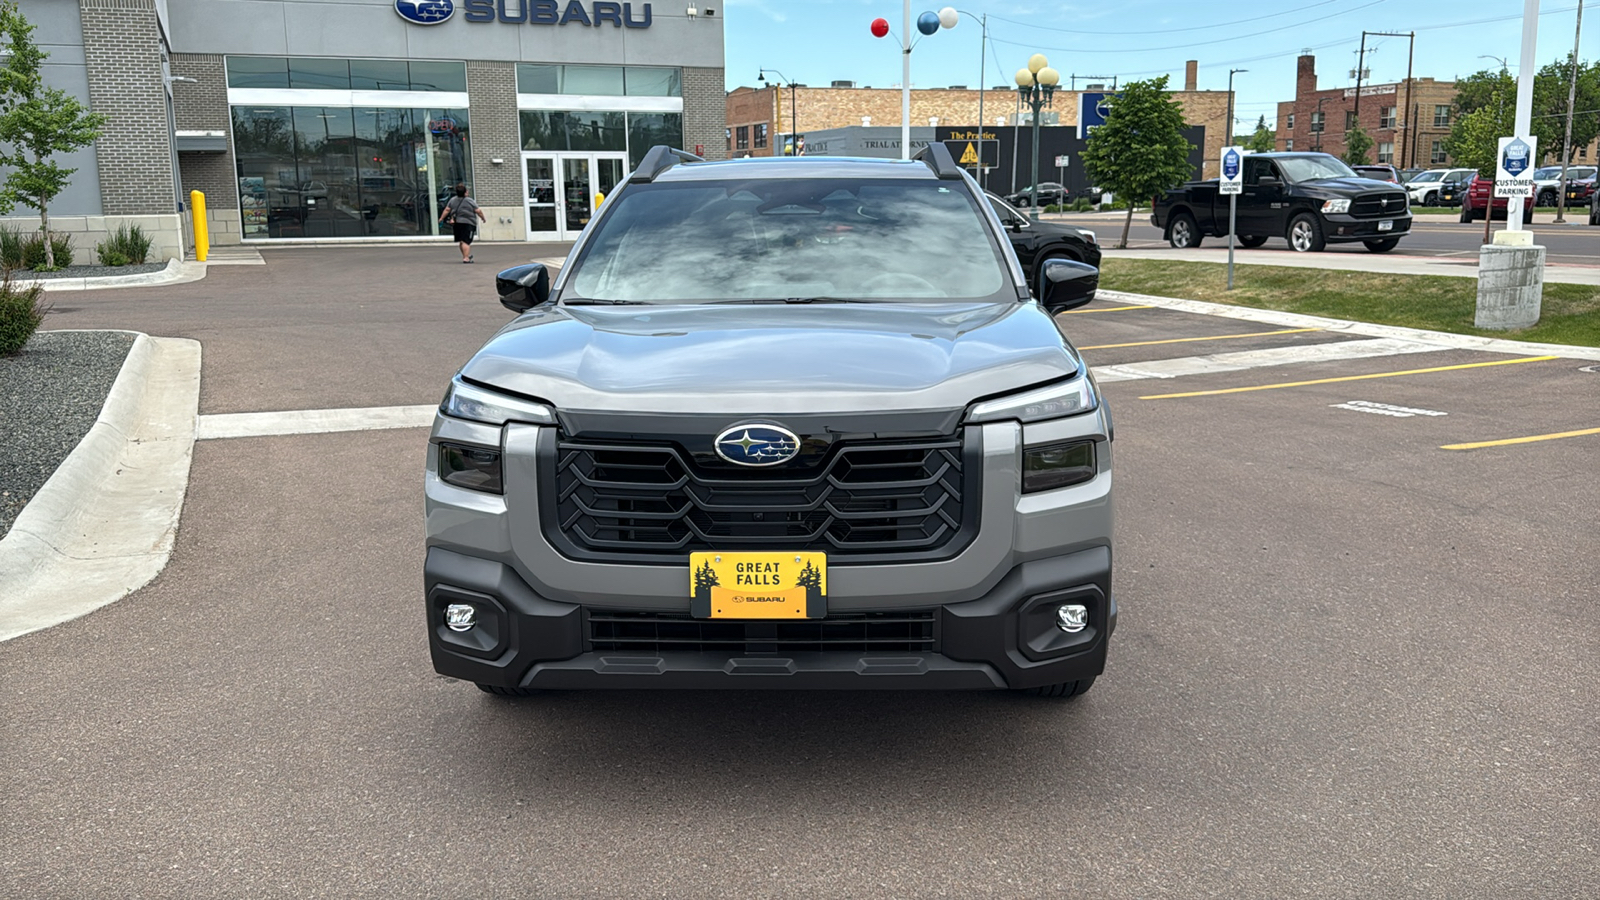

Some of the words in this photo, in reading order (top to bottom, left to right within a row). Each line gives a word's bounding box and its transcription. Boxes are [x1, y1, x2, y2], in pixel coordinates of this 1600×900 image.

[464, 0, 652, 28] SUBARU
[950, 131, 965, 139] The
[966, 131, 996, 139] Pratice
[736, 563, 780, 572] GREAT
[736, 575, 780, 585] FALLS
